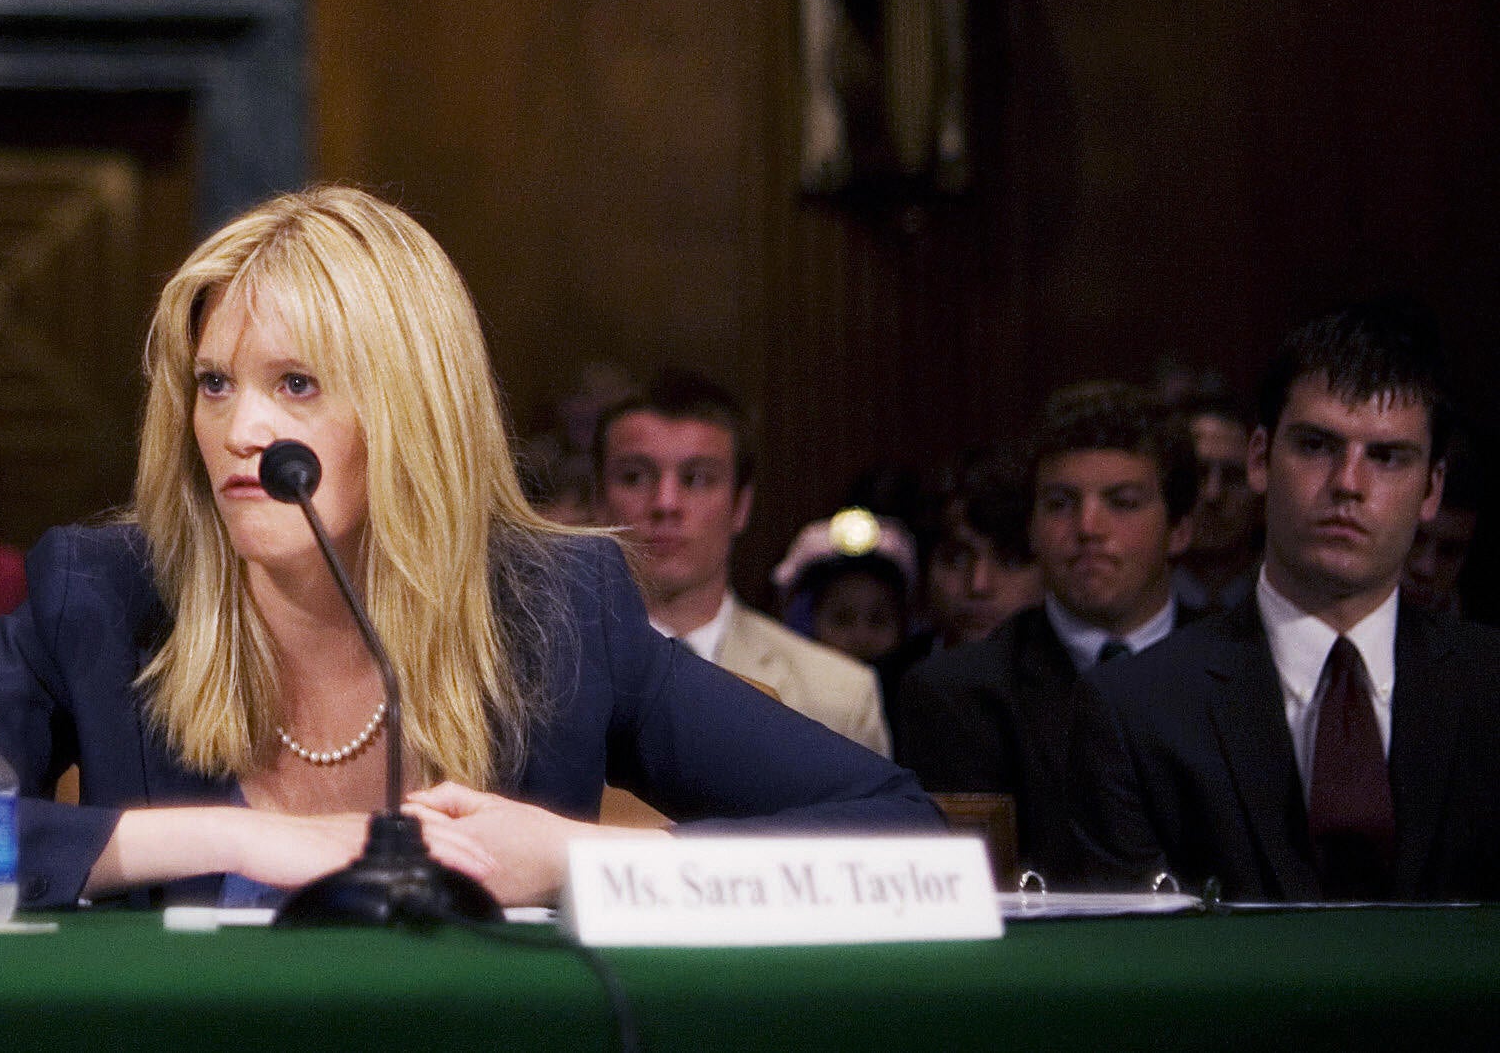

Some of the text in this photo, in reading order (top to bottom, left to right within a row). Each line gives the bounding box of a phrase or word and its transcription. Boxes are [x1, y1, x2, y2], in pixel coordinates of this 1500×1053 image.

[601, 860, 961, 916] Ms. Sara M. Taylor
